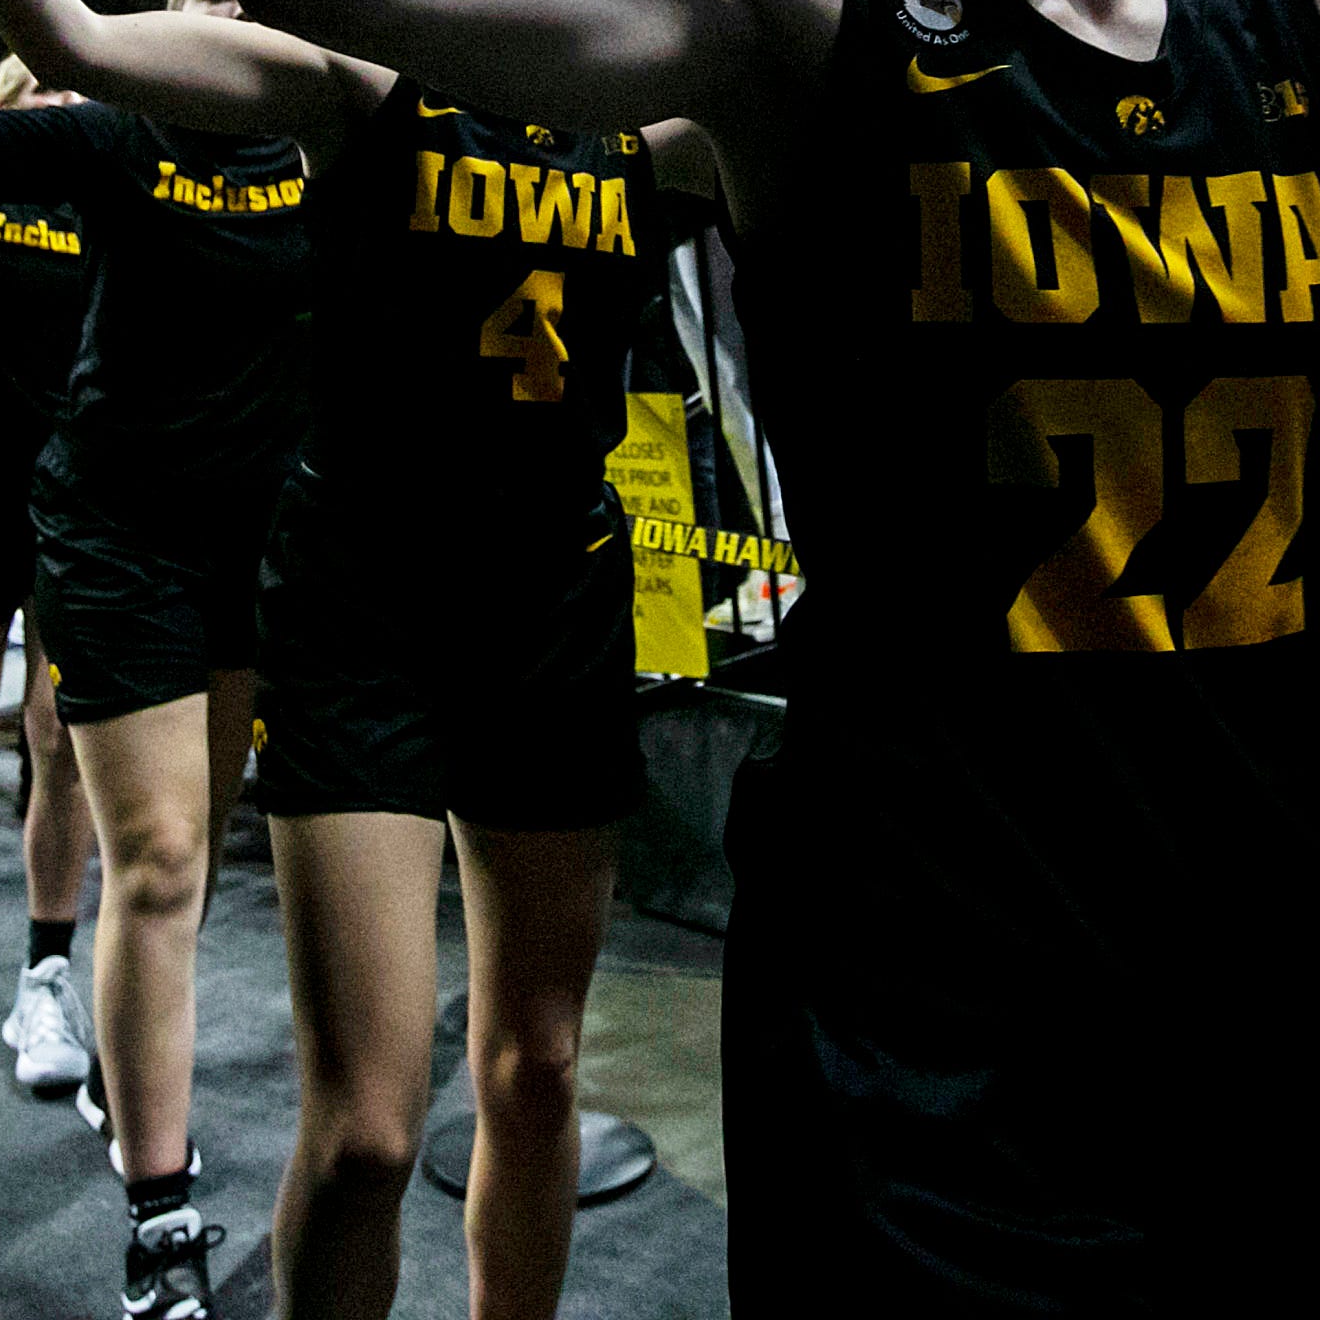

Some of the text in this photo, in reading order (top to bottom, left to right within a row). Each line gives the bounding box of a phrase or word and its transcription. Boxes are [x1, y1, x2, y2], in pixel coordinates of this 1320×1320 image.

[895, 10, 932, 42] United
[933, 34, 949, 46] As
[409, 150, 636, 257] IOWA
[479, 270, 569, 402] 4
[632, 516, 708, 560] IOWA
[987, 375, 1317, 653] 22
